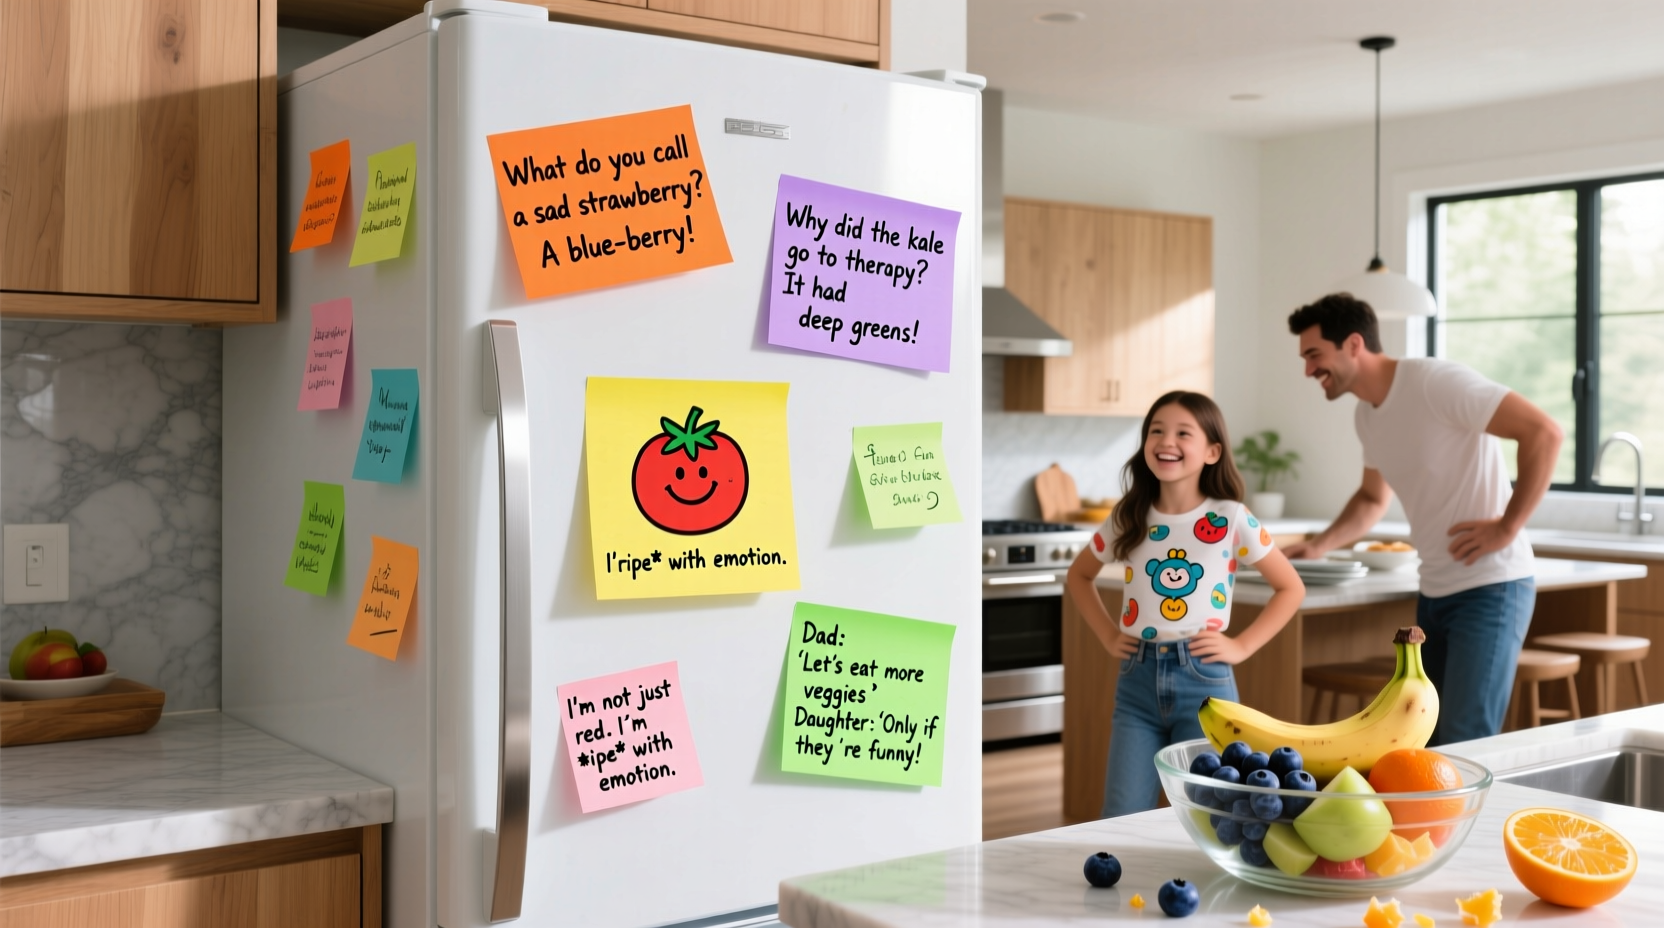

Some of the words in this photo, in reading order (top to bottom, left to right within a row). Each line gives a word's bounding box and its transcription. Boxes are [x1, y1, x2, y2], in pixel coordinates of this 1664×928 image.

[502, 155, 566, 186] What
[575, 149, 601, 175] do
[608, 150, 645, 181] you
[654, 134, 689, 163] call
[513, 211, 528, 226] a
[534, 193, 571, 224] sad
[578, 169, 703, 215] strawberry?
[542, 240, 560, 268] A
[567, 215, 695, 262] blue-berry!
[787, 202, 828, 241] Why
[835, 213, 864, 239] did
[871, 221, 900, 246] the
[908, 226, 944, 254] kale
[785, 245, 810, 269] go
[817, 245, 837, 267] to
[845, 249, 928, 289] therapy?
[782, 272, 805, 296] It
[812, 275, 847, 302] had
[799, 305, 843, 342] deep
[849, 320, 919, 345] greens!
[669, 548, 706, 570] with
[714, 547, 787, 567] emotion.
[802, 621, 845, 646] Dad:
[850, 660, 878, 677] eat
[885, 666, 924, 682] more
[567, 696, 595, 719] I'm
[603, 687, 631, 710] not
[637, 679, 671, 711] just
[576, 719, 611, 745] red.
[618, 714, 647, 735] I'm
[795, 706, 874, 737] Daughter:
[924, 716, 939, 739] if
[633, 731, 673, 757] with
[869, 739, 922, 771] funny!
[600, 764, 676, 791] emotion.
